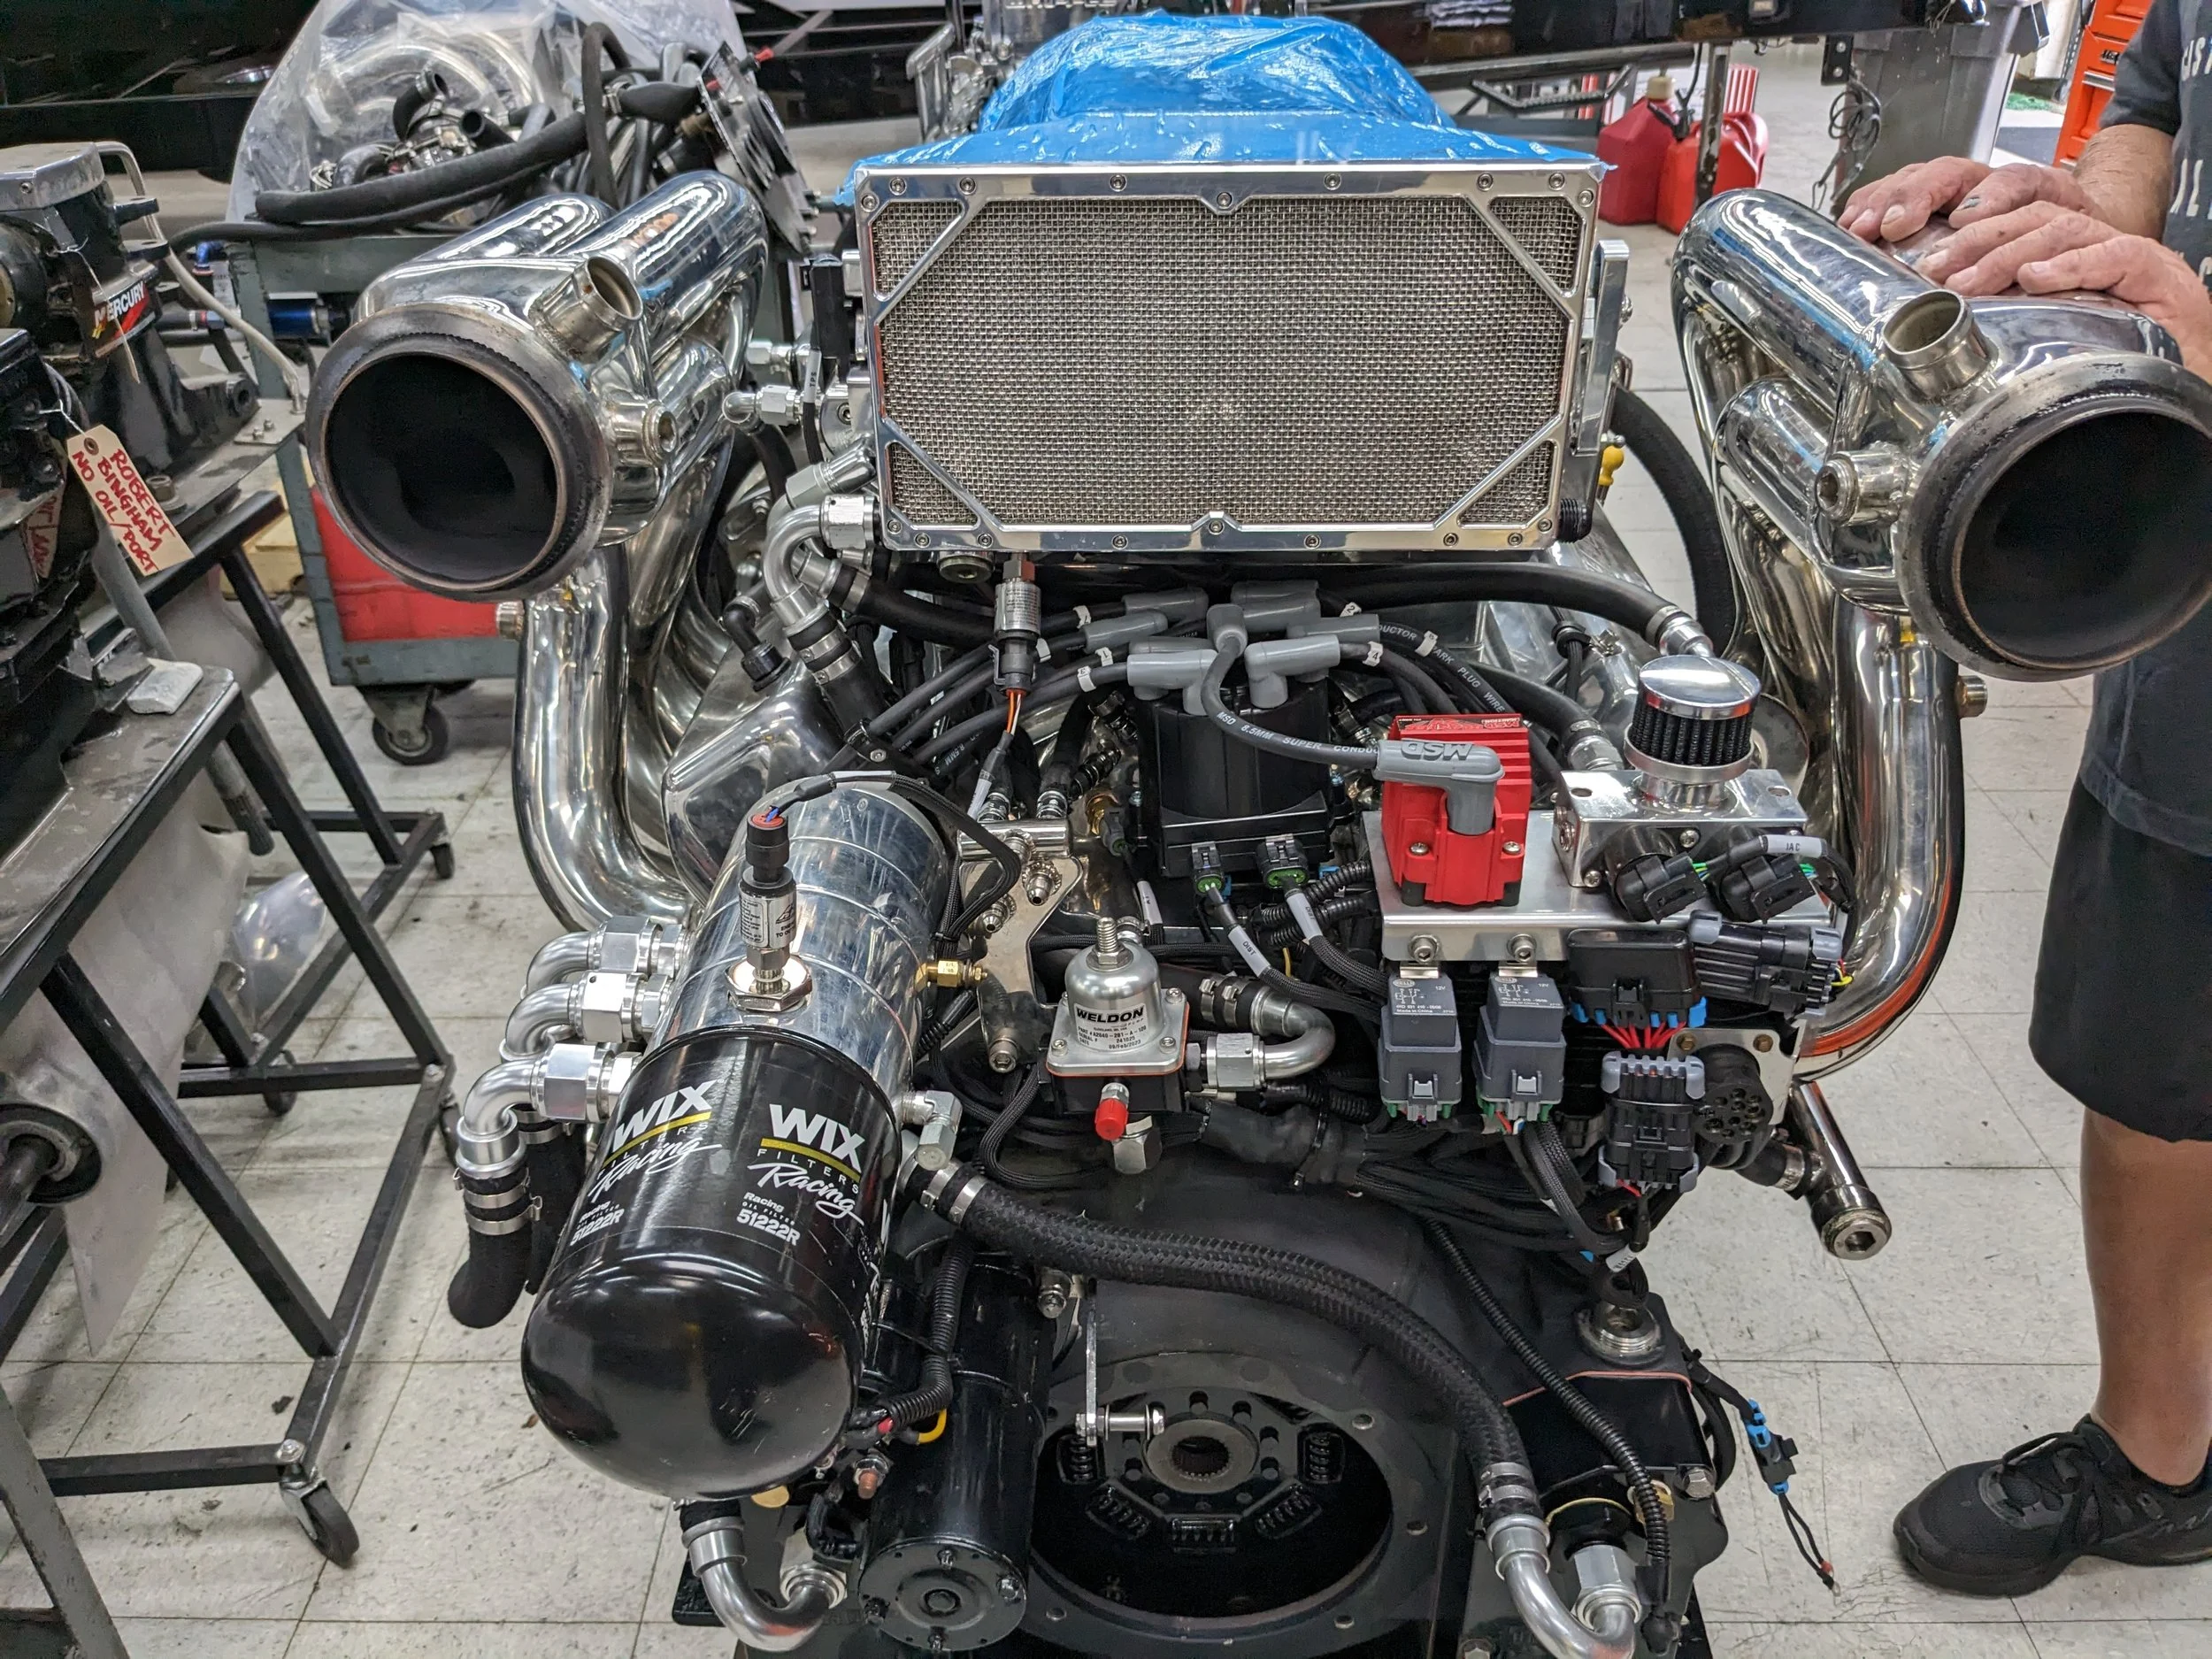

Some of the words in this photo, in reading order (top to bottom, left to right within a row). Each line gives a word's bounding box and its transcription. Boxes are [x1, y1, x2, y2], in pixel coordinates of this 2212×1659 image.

[94, 280, 145, 326] MERCURY
[73, 451, 95, 481] NO
[97, 457, 162, 551] BINGHAM
[110, 449, 175, 537] ROBERT
[1457, 667, 1480, 688] PLUG
[1484, 692, 1505, 714] WIRE
[1216, 711, 1236, 726] MSD
[1240, 724, 1275, 741] 8.5MM
[1282, 736, 1323, 751] SUPER
[1401, 740, 1473, 761] MSD
[1242, 941, 1256, 956] DIST
[1076, 1005, 1144, 1023] WELDON
[613, 1079, 717, 1153] WIX
[769, 1103, 865, 1173] WIX
[588, 1137, 722, 1203] Racing
[757, 1148, 859, 1194] FILTERS
[741, 1201, 758, 1210] OIL
[763, 1208, 795, 1225] FILTER
[743, 1192, 785, 1213] Racing
[747, 1162, 864, 1227] Racing
[570, 1208, 625, 1246] 51222R
[736, 1208, 801, 1247] 51222R
